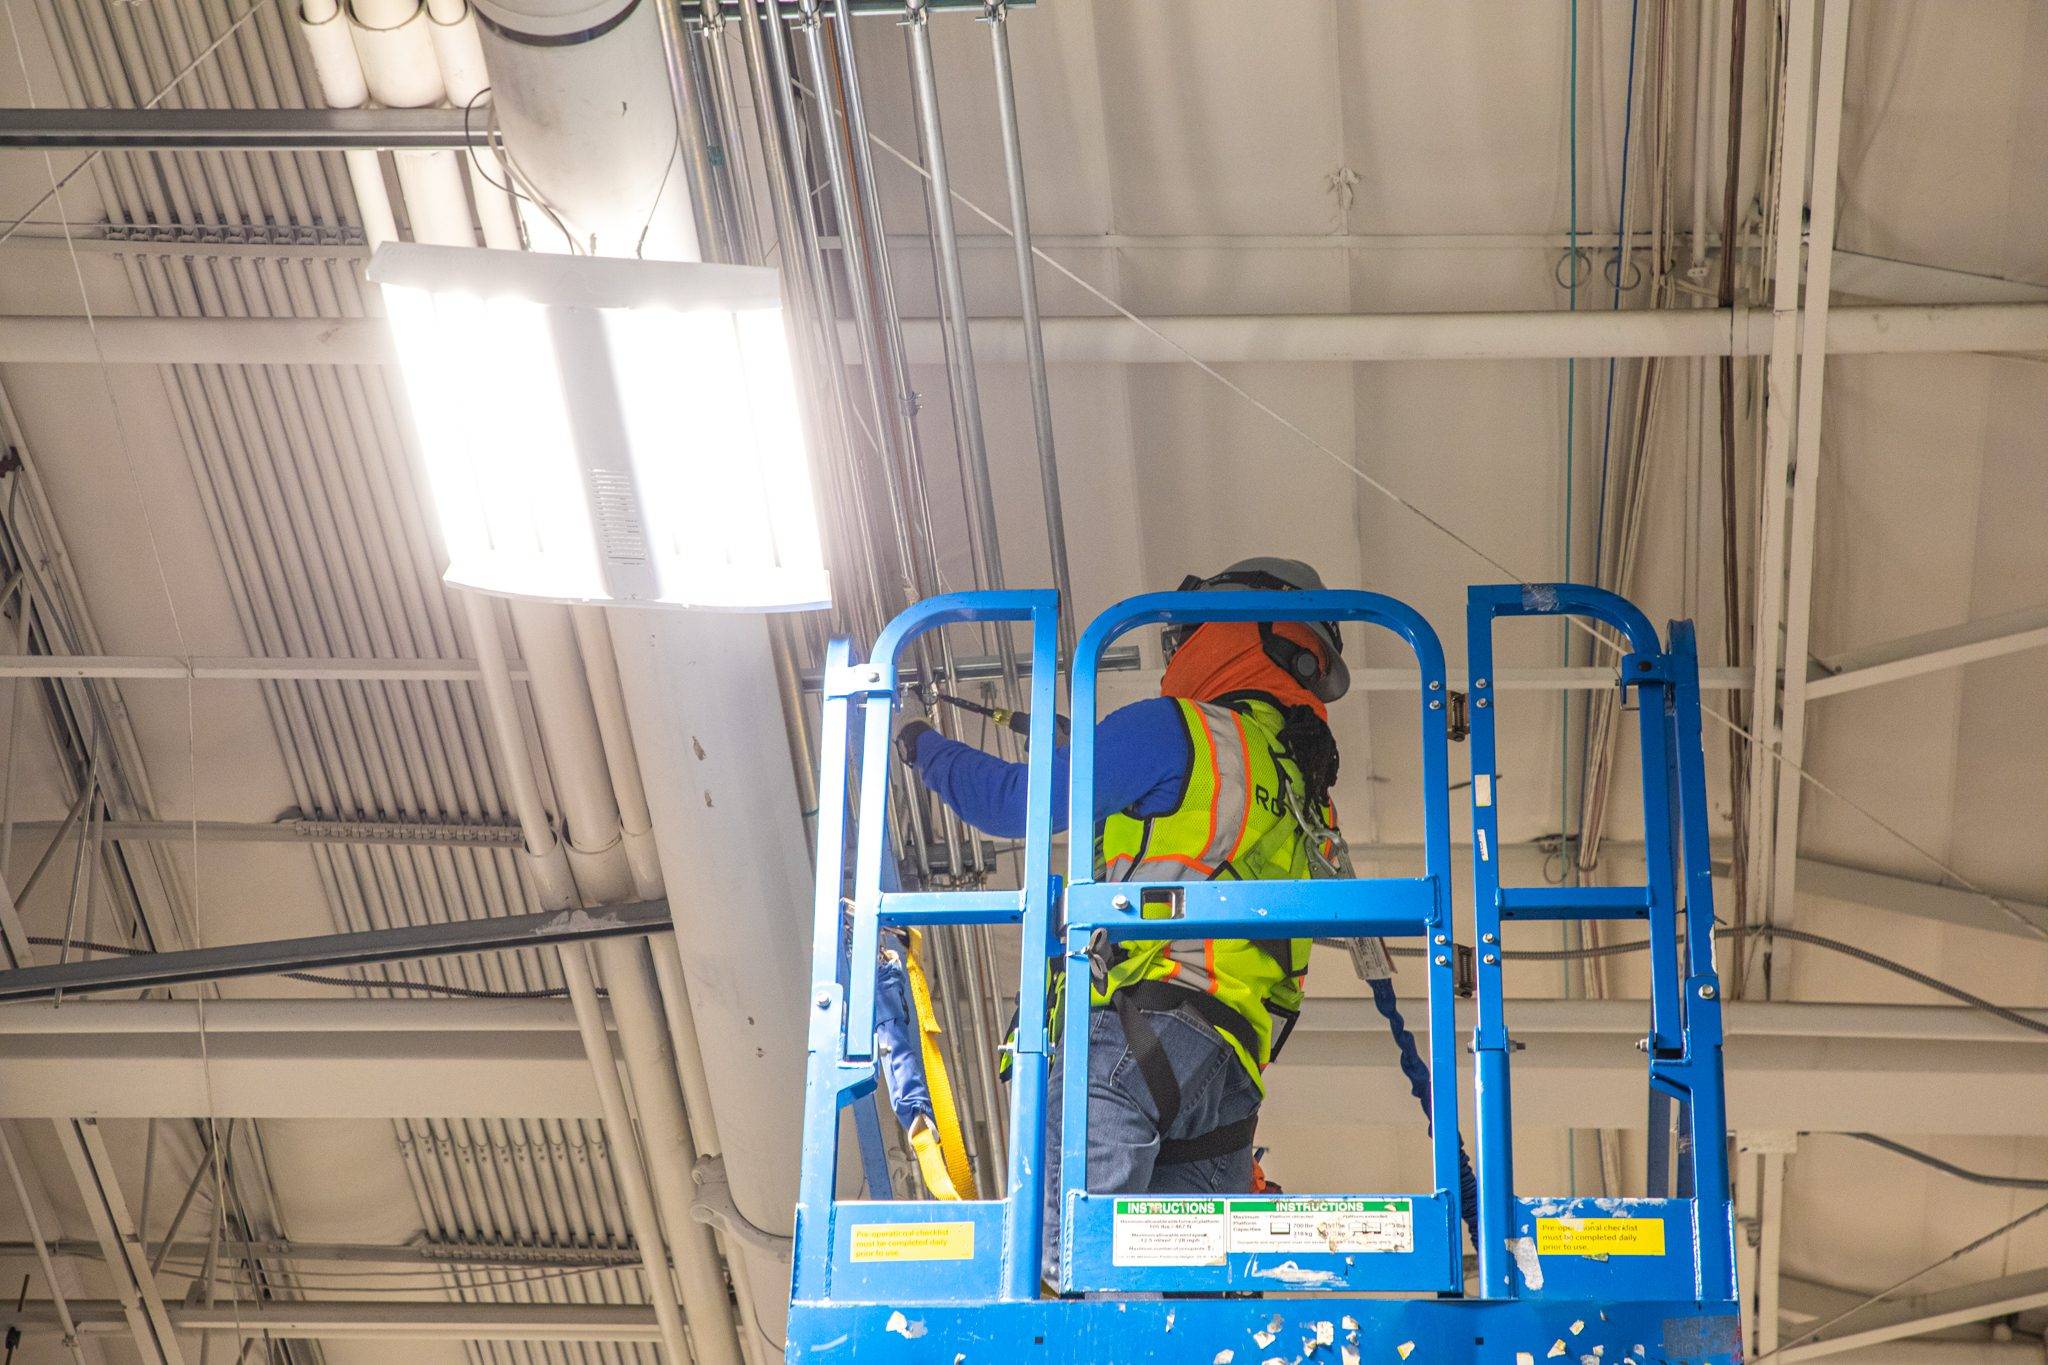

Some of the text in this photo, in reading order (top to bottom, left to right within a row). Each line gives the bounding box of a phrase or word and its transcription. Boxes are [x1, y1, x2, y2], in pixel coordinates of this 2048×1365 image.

[1127, 1202, 1215, 1214] INSTRUCTIONS
[1275, 1202, 1364, 1212] INSTRUCTIONS
[1575, 1234, 1617, 1242] completed
[1618, 1234, 1637, 1242] daily
[887, 1239, 928, 1247] completed
